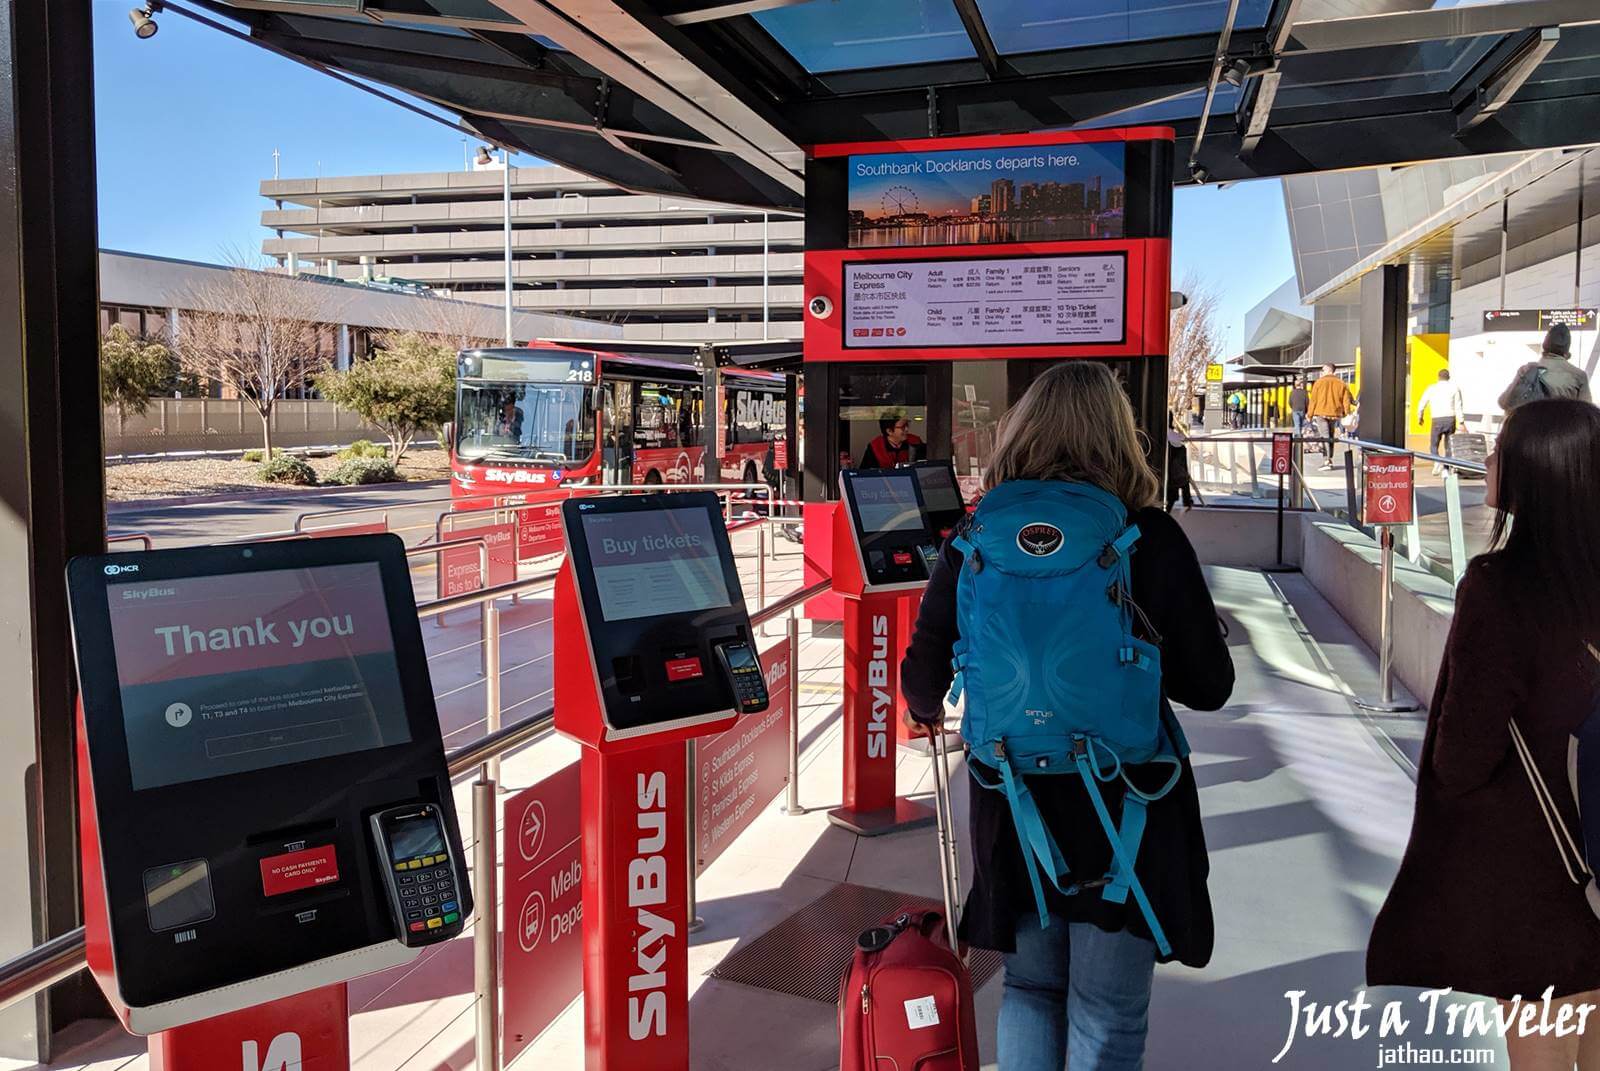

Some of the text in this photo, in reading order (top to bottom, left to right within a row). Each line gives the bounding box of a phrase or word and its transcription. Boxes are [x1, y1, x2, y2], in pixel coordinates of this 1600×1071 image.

[857, 154, 1080, 176] Southbank Docklands departs here.
[853, 271, 913, 280] Melbourne City
[853, 282, 886, 291] Express
[567, 370, 592, 382] 218
[736, 391, 786, 424] SkyBus
[484, 469, 546, 484] SkyBus
[1369, 464, 1408, 474] SkyBus
[1369, 481, 1408, 489] Departures
[1022, 526, 1057, 537] OSPREY
[602, 534, 701, 556] Buy tickets
[121, 565, 140, 573] NCR
[122, 586, 176, 600] SkyBus
[448, 581, 464, 595] Bus
[464, 579, 472, 589] to
[155, 614, 354, 656] Thank you
[867, 615, 892, 758] SkyBus
[288, 696, 322, 707] Melbourne
[323, 694, 336, 703] City
[711, 739, 740, 773] Southbank
[766, 707, 784, 730] Express
[711, 752, 755, 796] St Kilda Express
[711, 769, 758, 820] Peninsula Express
[711, 793, 756, 844] Western Express
[298, 858, 327, 868] PAYMENTS
[315, 875, 337, 883] SkyBus
[628, 771, 676, 1041] SkyBus
